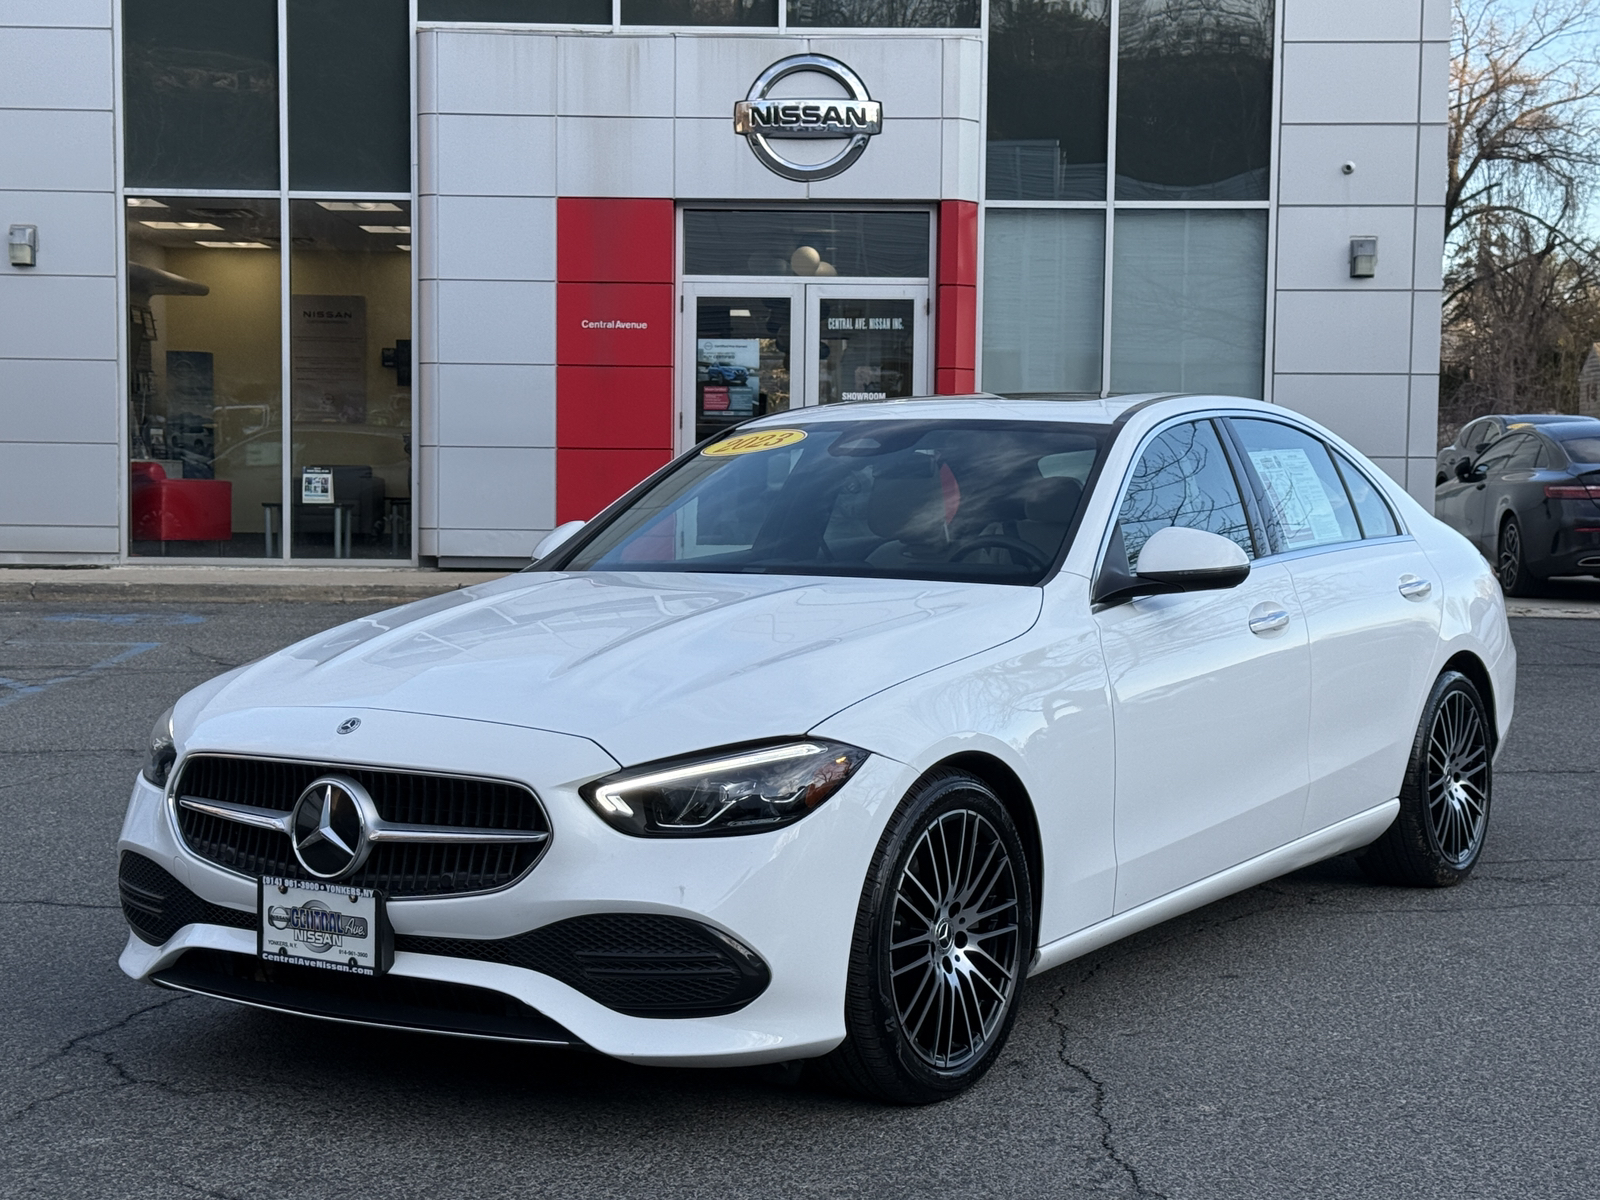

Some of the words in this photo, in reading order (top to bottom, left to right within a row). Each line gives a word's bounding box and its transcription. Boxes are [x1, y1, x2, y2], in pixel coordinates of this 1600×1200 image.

[749, 105, 867, 127] NISSAN
[303, 310, 353, 319] NISSAN
[828, 317, 853, 330] CENTRAL
[854, 318, 868, 330] AVE.
[869, 318, 891, 330] NISSAN
[892, 318, 904, 330] INC.
[581, 319, 615, 329] Central
[615, 320, 648, 330] Avenue
[842, 392, 886, 401] SHOWROOM
[713, 432, 794, 453] 2023
[292, 907, 343, 933] CENTRAL
[345, 918, 366, 935] Ave.
[294, 929, 343, 947] NISSAN
[263, 953, 373, 975] CentralAveNissan.com
